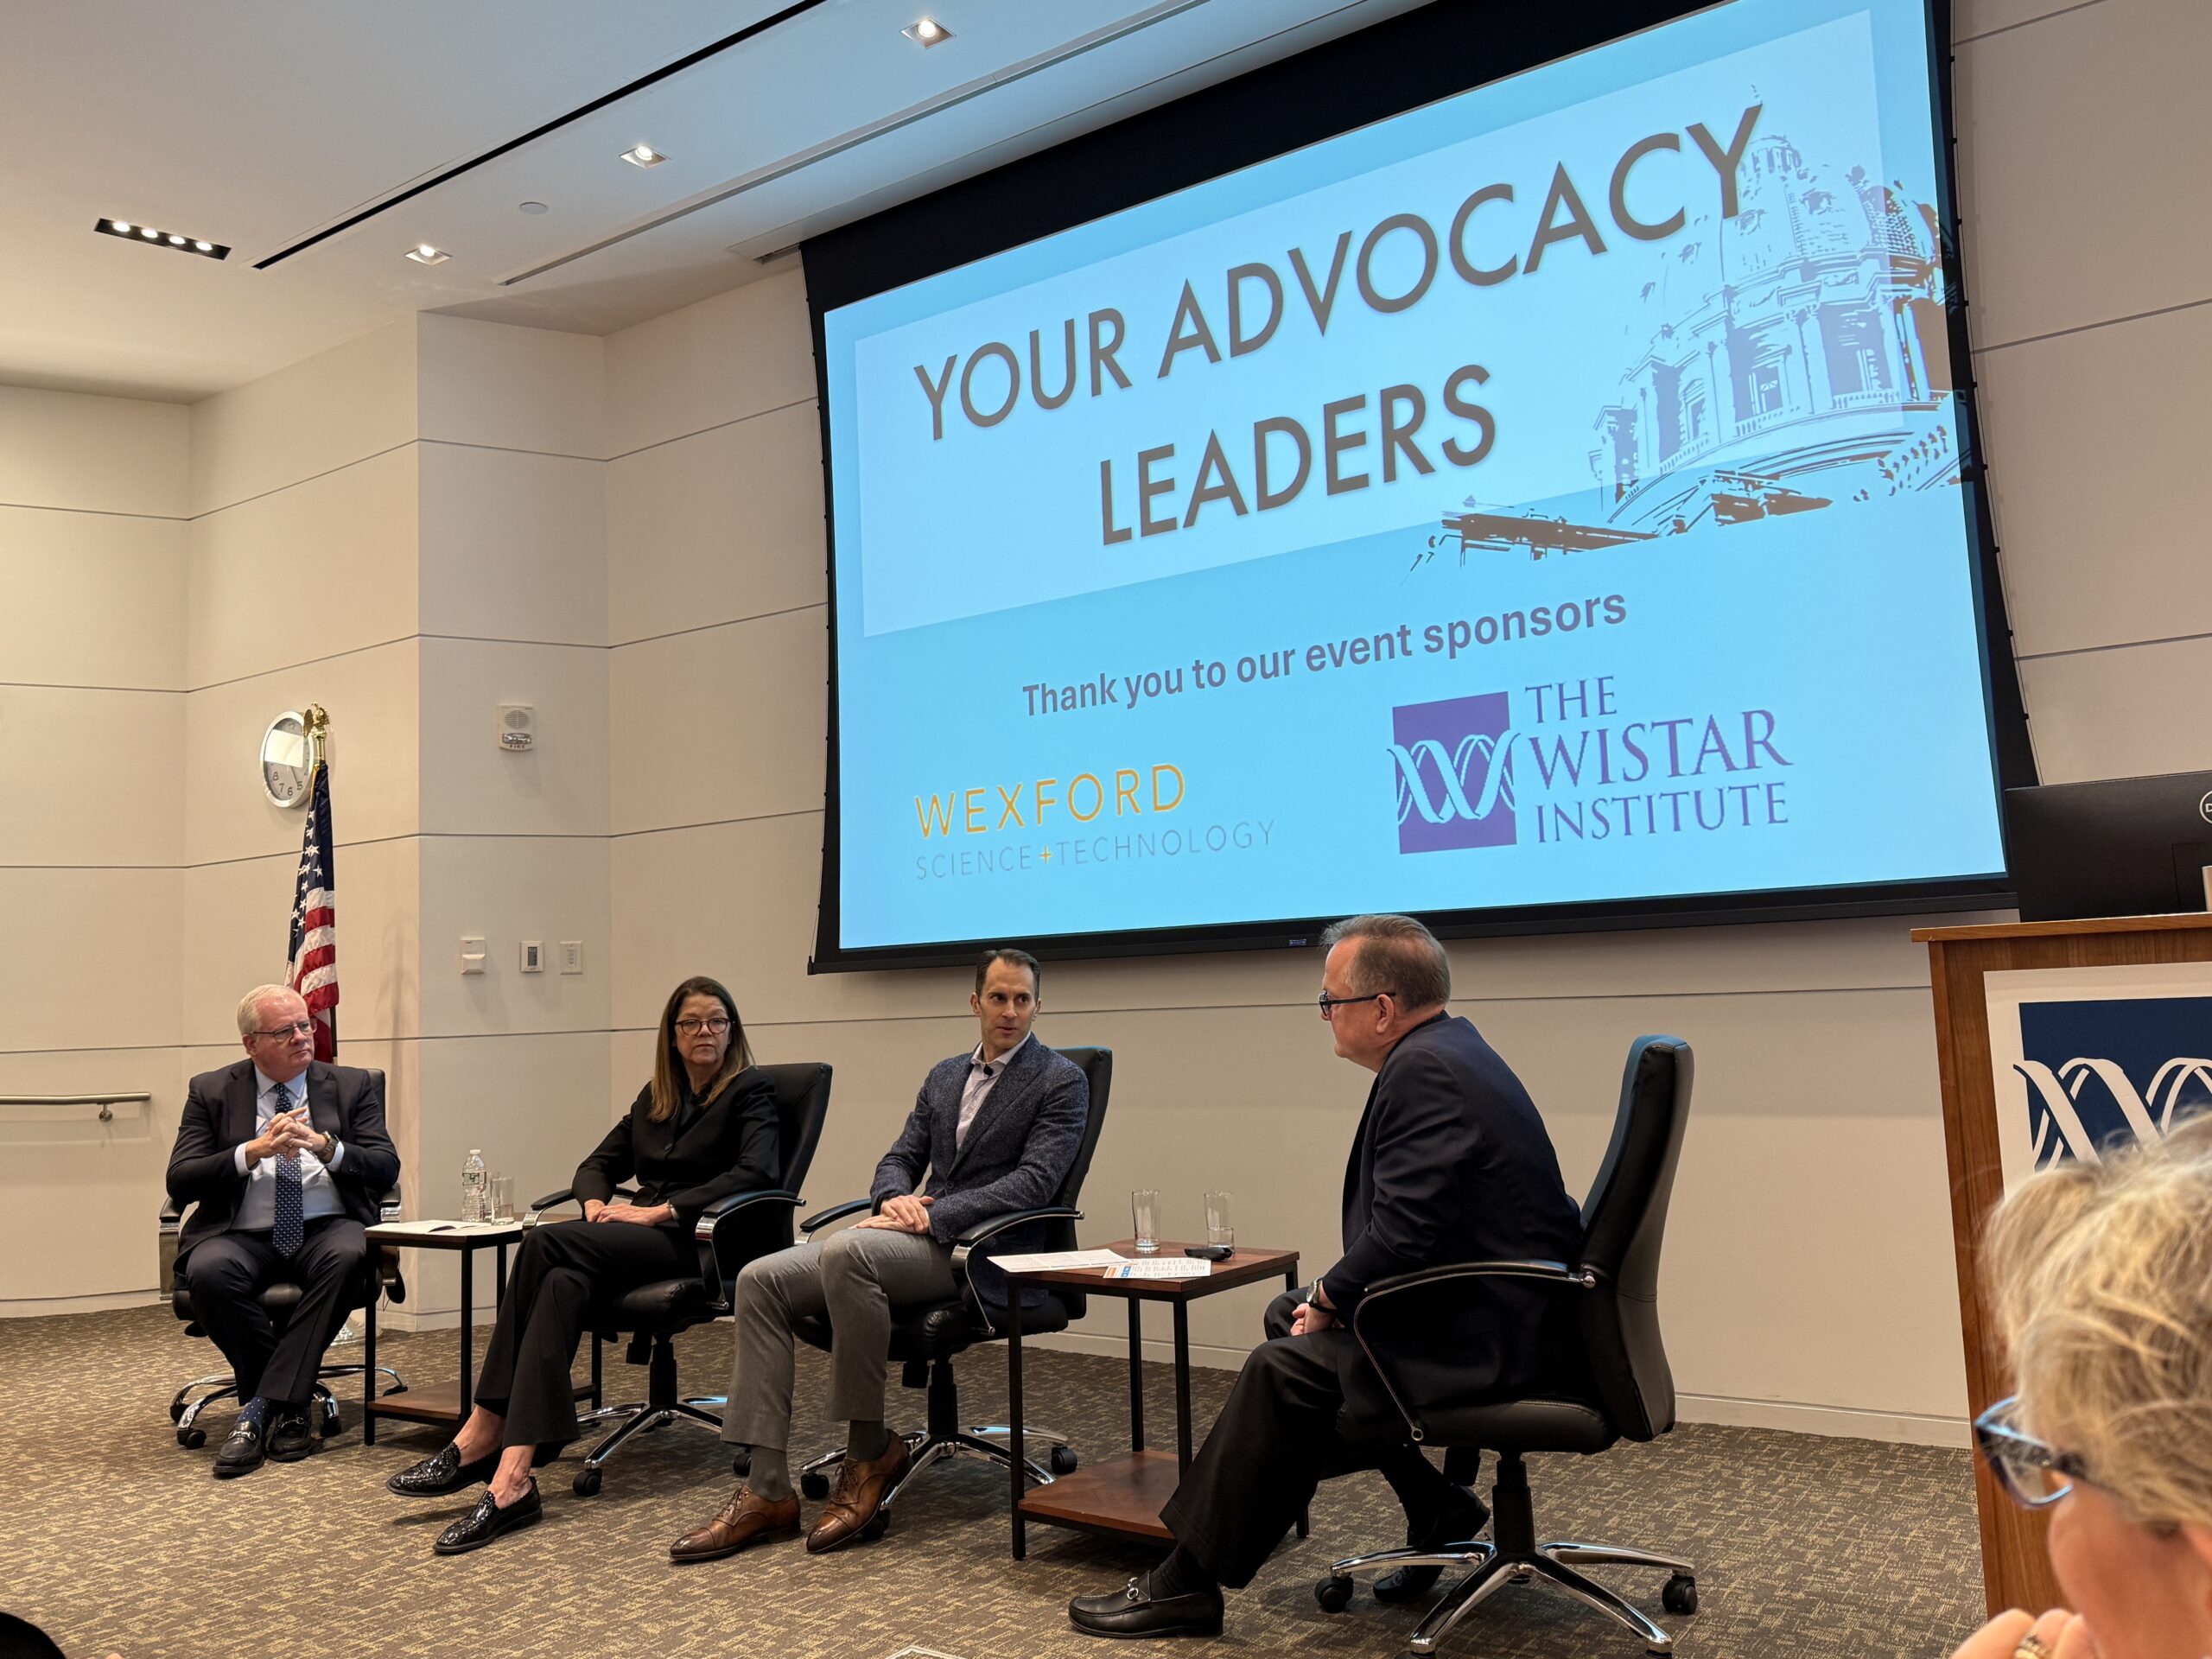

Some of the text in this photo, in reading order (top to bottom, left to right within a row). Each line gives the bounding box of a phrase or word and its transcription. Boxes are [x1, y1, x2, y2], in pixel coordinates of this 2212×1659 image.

[912, 100, 1766, 442] YOUR ADVOCACY
[1100, 364, 1497, 547] LEADERS
[1022, 594, 1627, 716] Thank you to our event sponsors
[1524, 675, 1618, 724] THE
[1528, 709, 1795, 791] WISTAR
[914, 763, 1186, 839] WEXFORD
[1536, 781, 1789, 844] INSTITUTE
